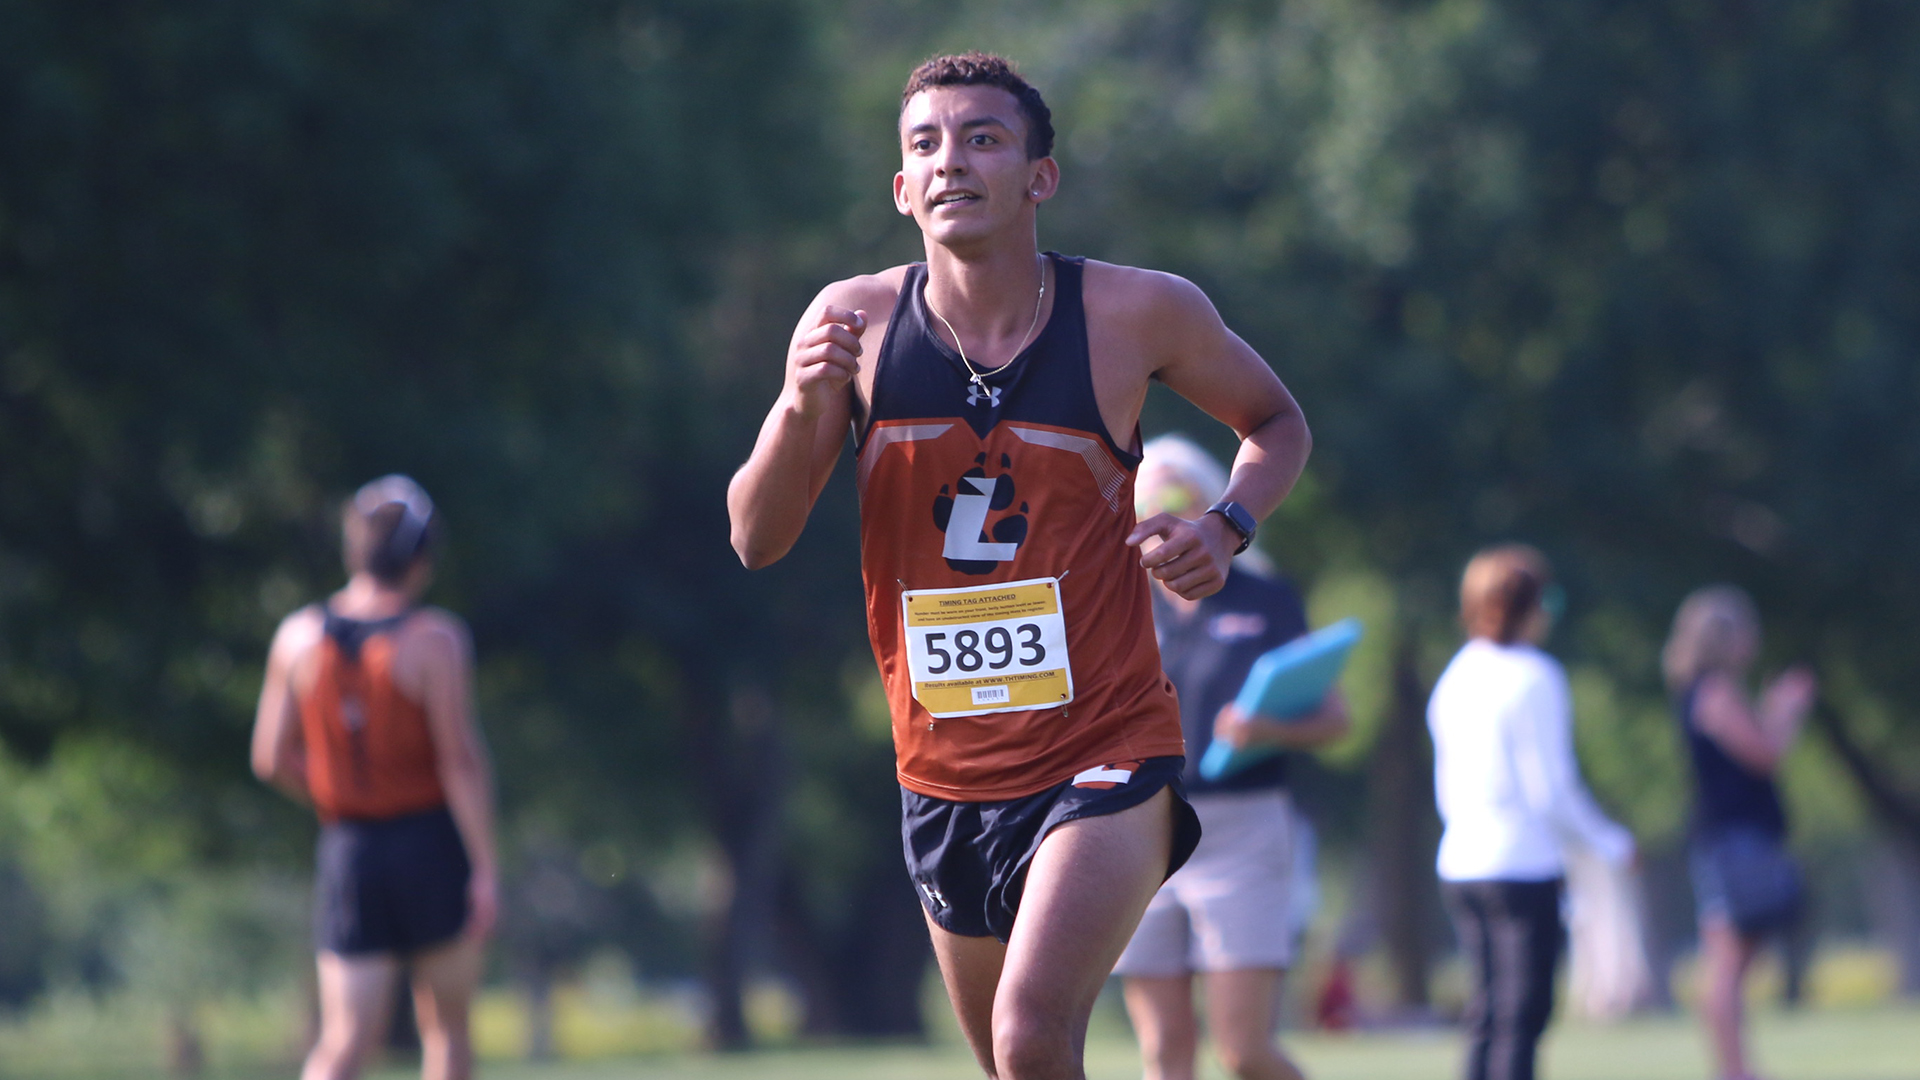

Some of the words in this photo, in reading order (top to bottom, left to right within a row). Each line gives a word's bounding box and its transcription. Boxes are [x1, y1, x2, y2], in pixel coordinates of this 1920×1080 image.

[941, 476, 1018, 562] L
[939, 599, 962, 607] TIMING
[978, 593, 1016, 603] ATTACHED
[925, 623, 1046, 675] 5893
[983, 671, 1055, 684] WWW.THTIMING.COM
